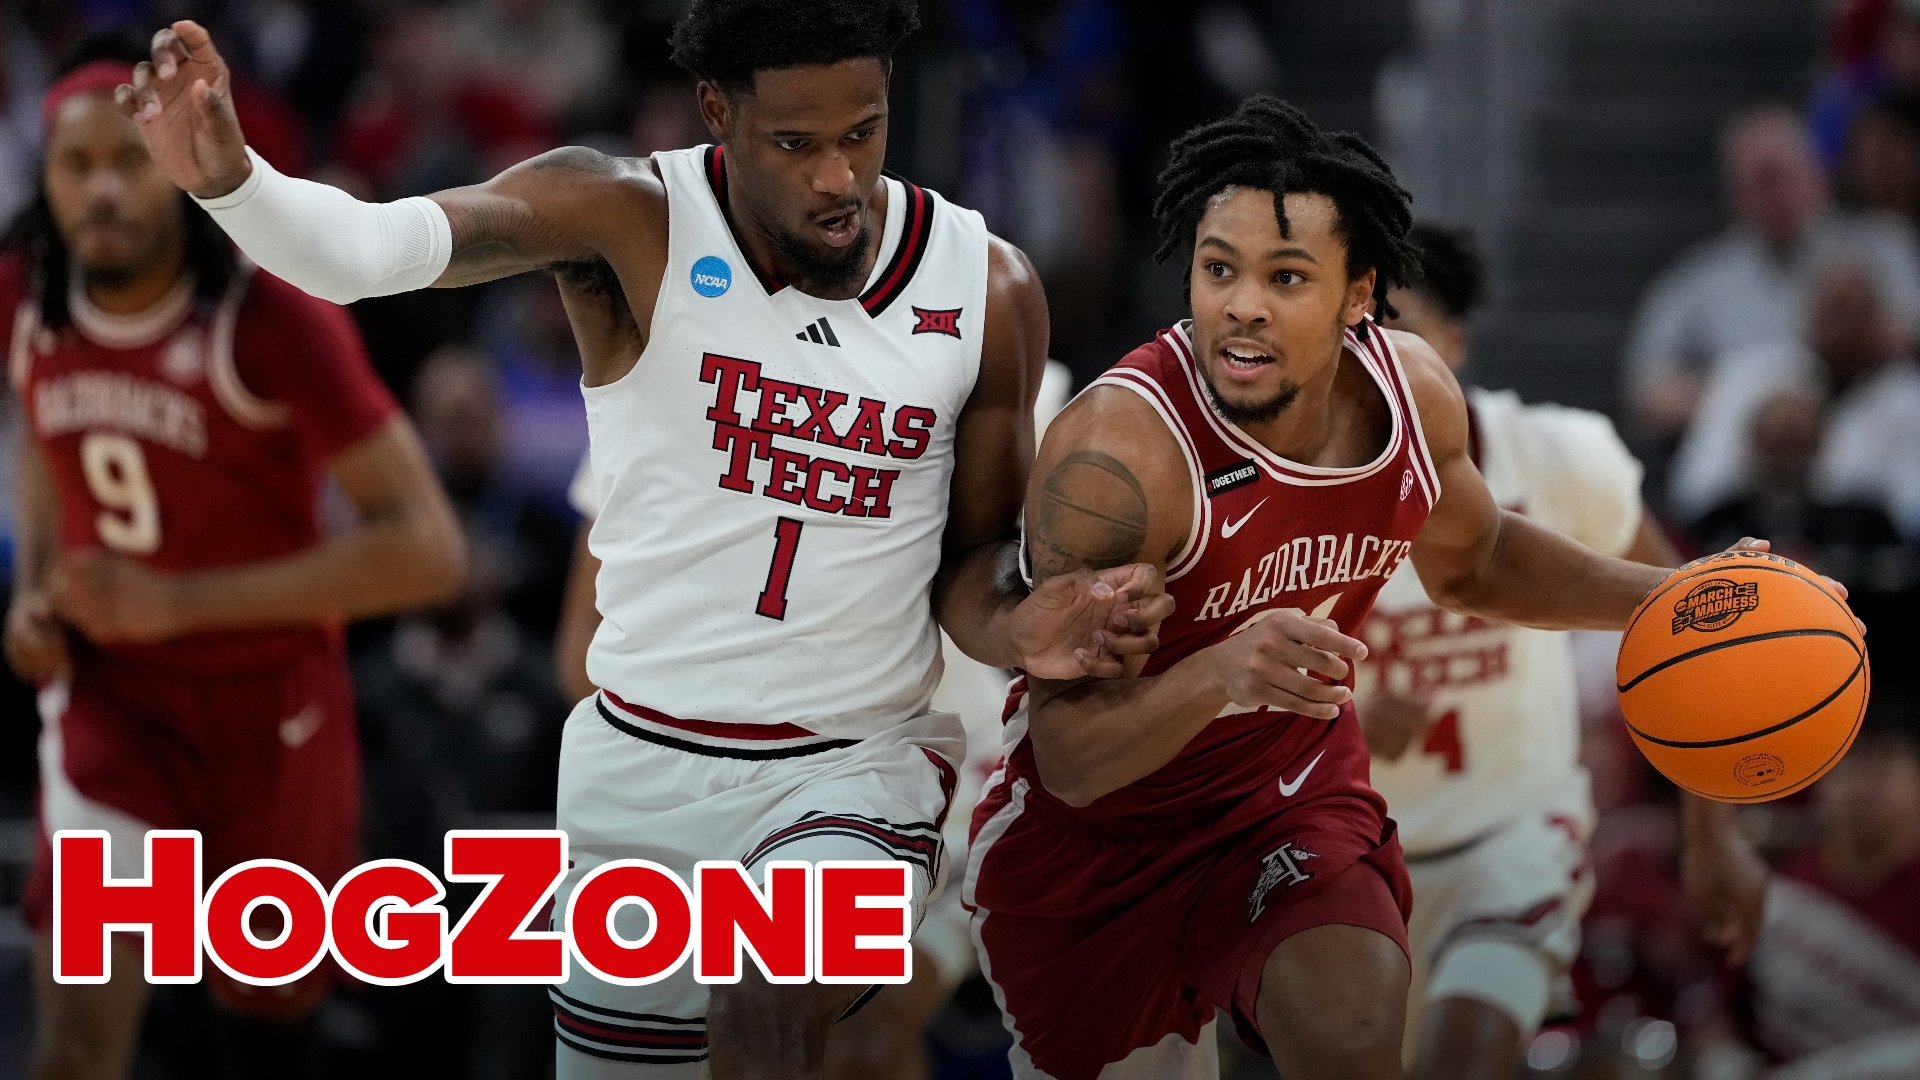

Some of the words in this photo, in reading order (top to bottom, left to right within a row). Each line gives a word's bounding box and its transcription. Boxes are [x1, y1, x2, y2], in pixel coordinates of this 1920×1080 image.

[695, 273, 729, 289] NCAA
[917, 309, 960, 334] XII
[699, 352, 937, 460] TEXAS
[80, 433, 162, 555] 9
[712, 421, 902, 519] TECH
[1211, 465, 1256, 490] TOGETHER
[755, 516, 804, 621] 1
[1194, 532, 1411, 622] RAZORBACKS
[1687, 587, 1734, 610] MARCH
[1694, 595, 1758, 619] MADNESS
